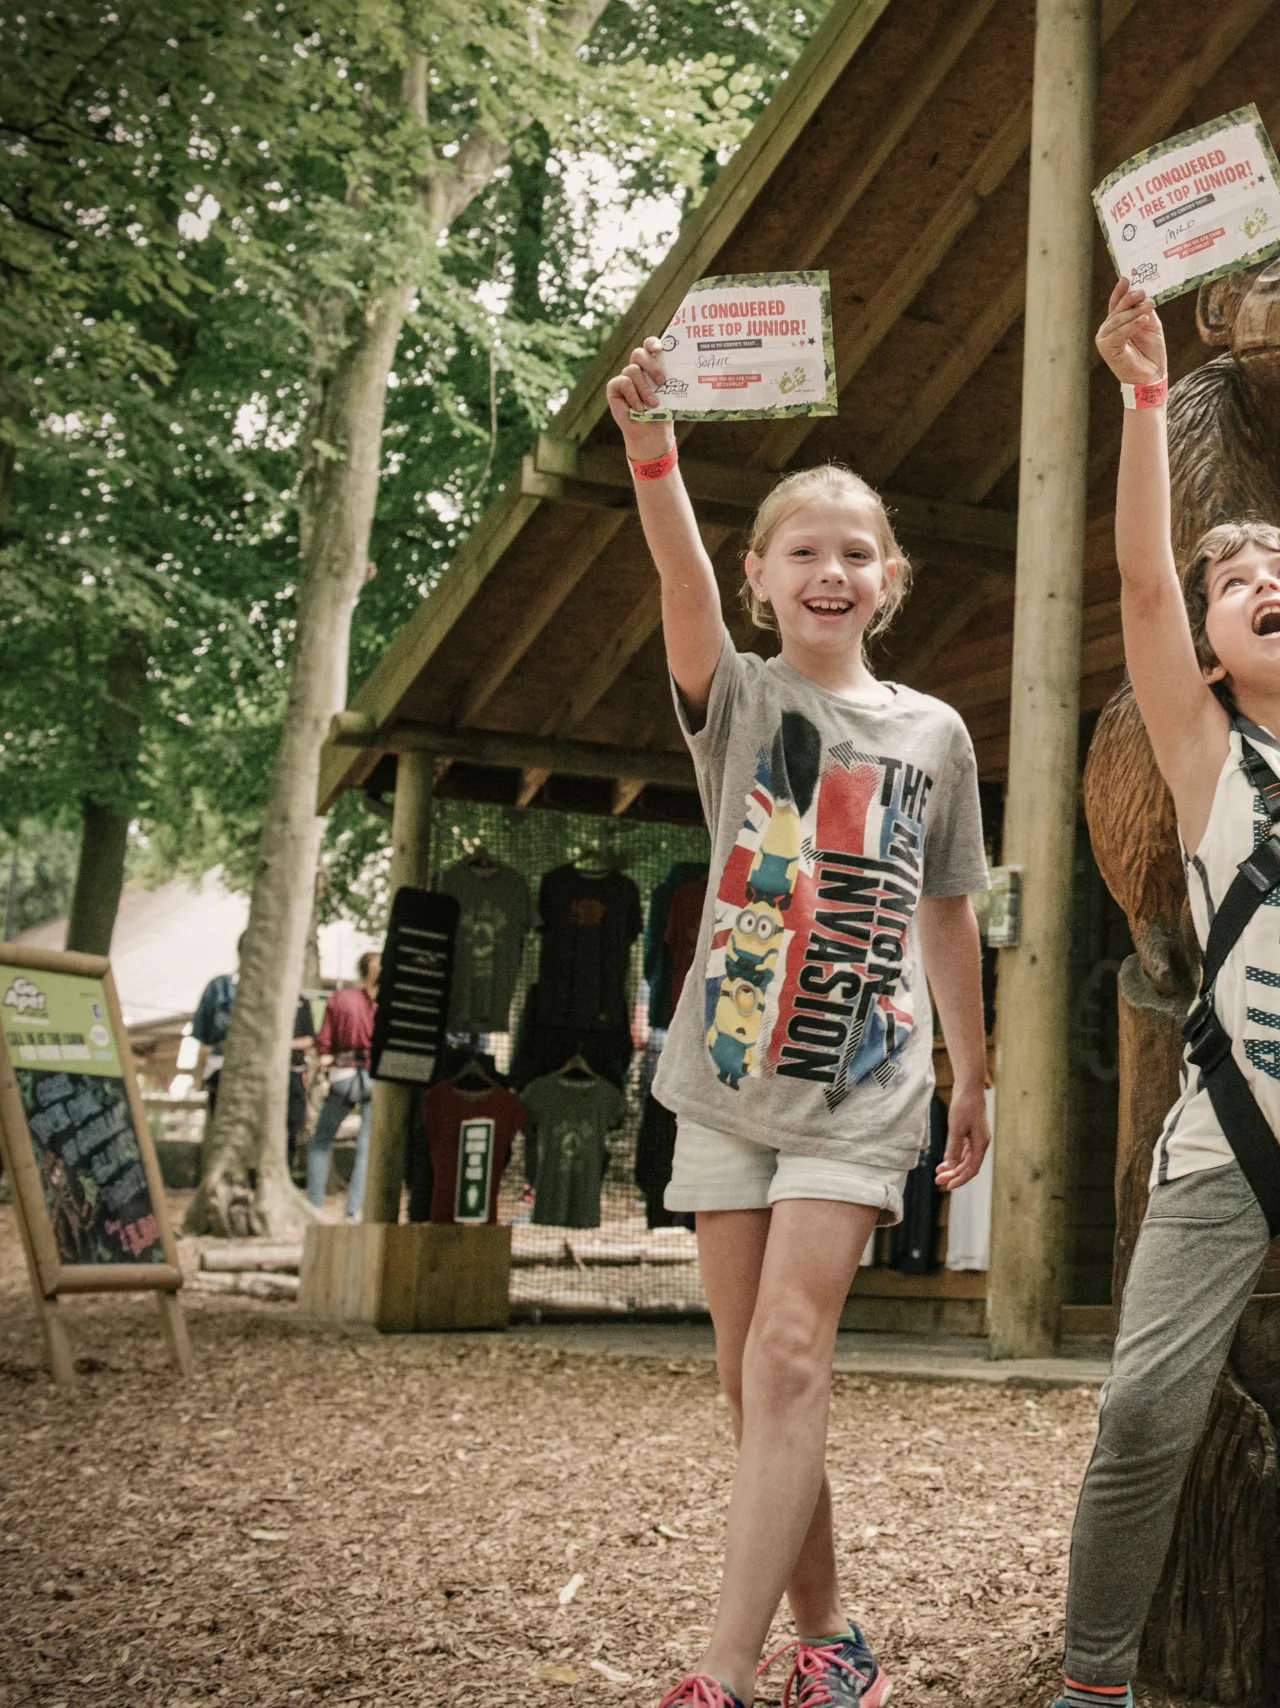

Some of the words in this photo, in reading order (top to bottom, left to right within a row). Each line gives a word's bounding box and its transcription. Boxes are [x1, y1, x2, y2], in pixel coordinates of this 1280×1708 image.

[1110, 190, 1137, 224] YES!
[1135, 185, 1146, 202] I
[1144, 149, 1227, 196] CONQUERED
[1137, 195, 1167, 220] TREE
[1165, 184, 1190, 206] TOP
[1193, 160, 1254, 196] JUNIOR!
[1165, 219, 1195, 245] MILO
[685, 323, 715, 339] TREE
[719, 321, 743, 337] TOP
[746, 319, 807, 337] JUNIOR!
[691, 304, 697, 322] I
[701, 299, 786, 320] CONQUERED
[878, 756, 934, 824] THE
[776, 850, 882, 1084] INVASION
